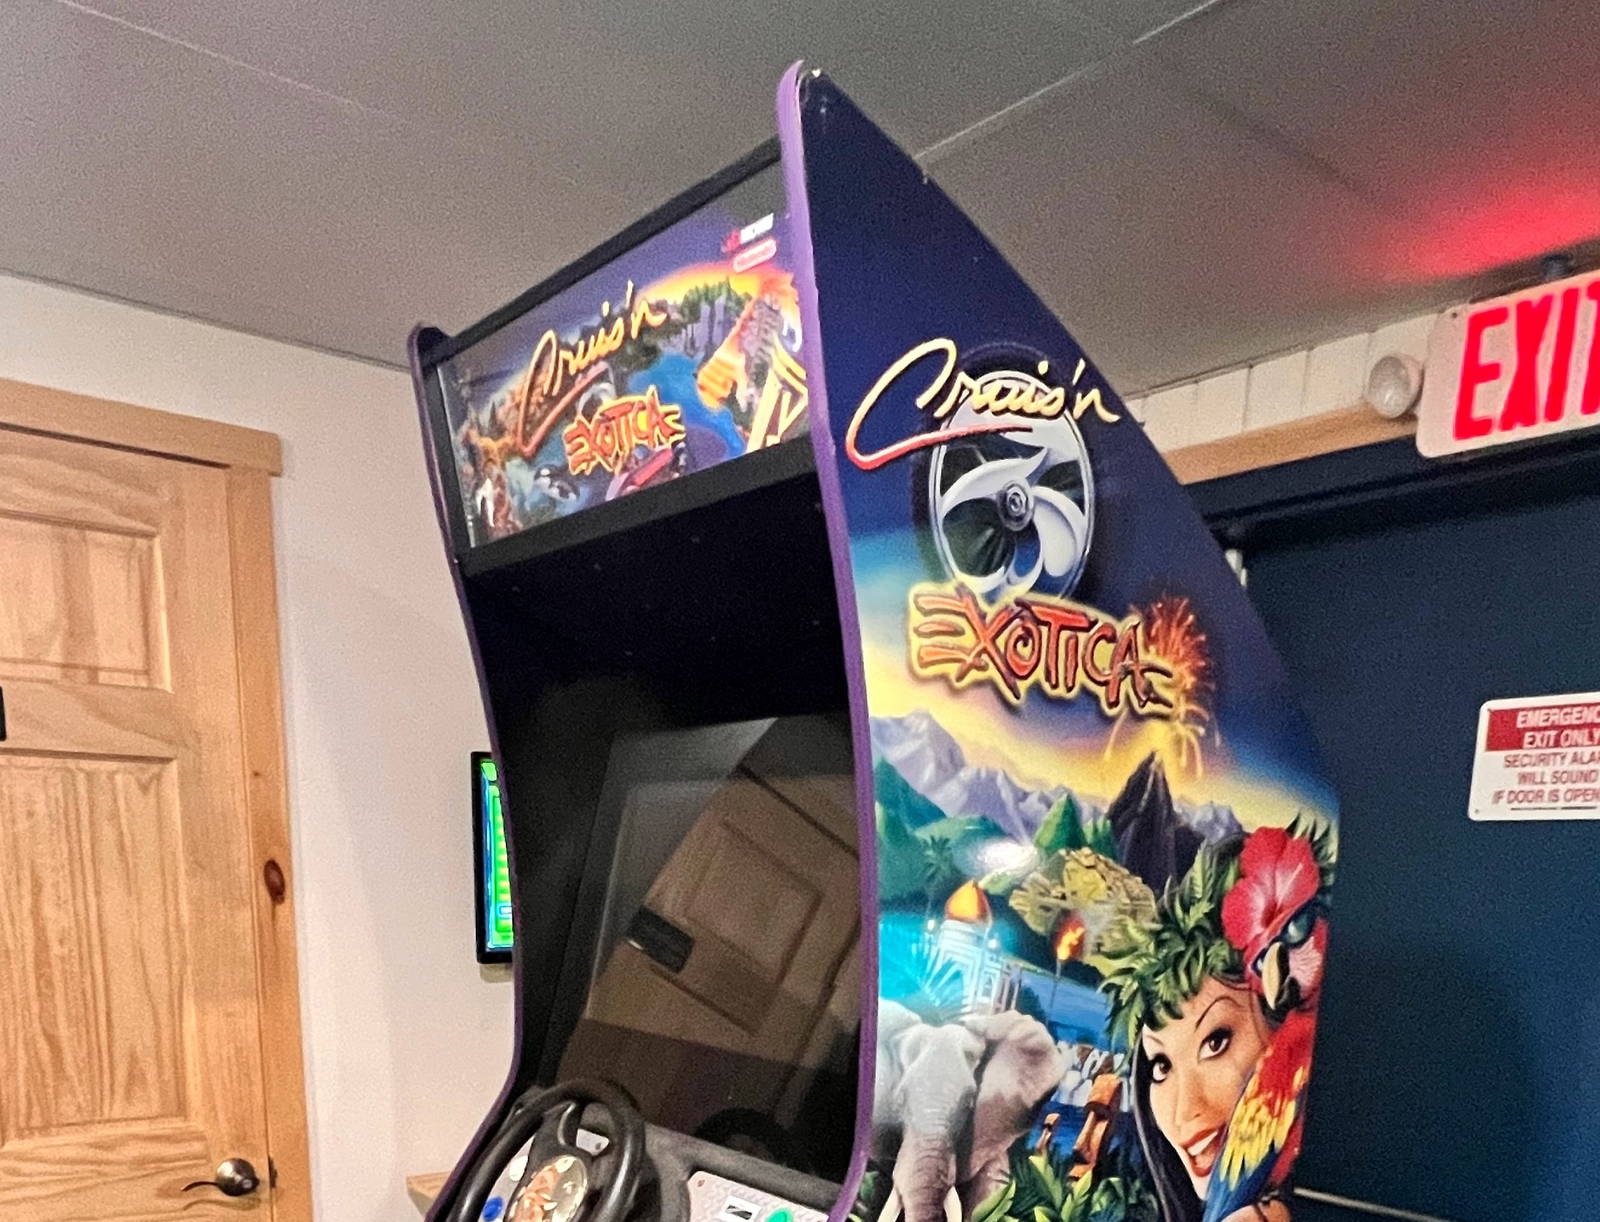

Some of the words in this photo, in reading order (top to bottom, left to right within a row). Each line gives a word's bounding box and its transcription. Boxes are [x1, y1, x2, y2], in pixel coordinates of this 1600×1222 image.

[1453, 280, 1600, 441] EXIT
[563, 385, 686, 476] EXOTICA
[845, 337, 1121, 471] Cruis'n
[911, 584, 1175, 712] EXOTICA
[1504, 751, 1568, 768] SECURITY
[1523, 730, 1557, 749] EXIT
[1560, 727, 1600, 748] ONLY
[1492, 789, 1505, 804] IF
[1507, 789, 1545, 804] DOOR
[1548, 788, 1560, 803] IS
[1517, 771, 1547, 785] WILL
[1550, 769, 1599, 785] SOUND
